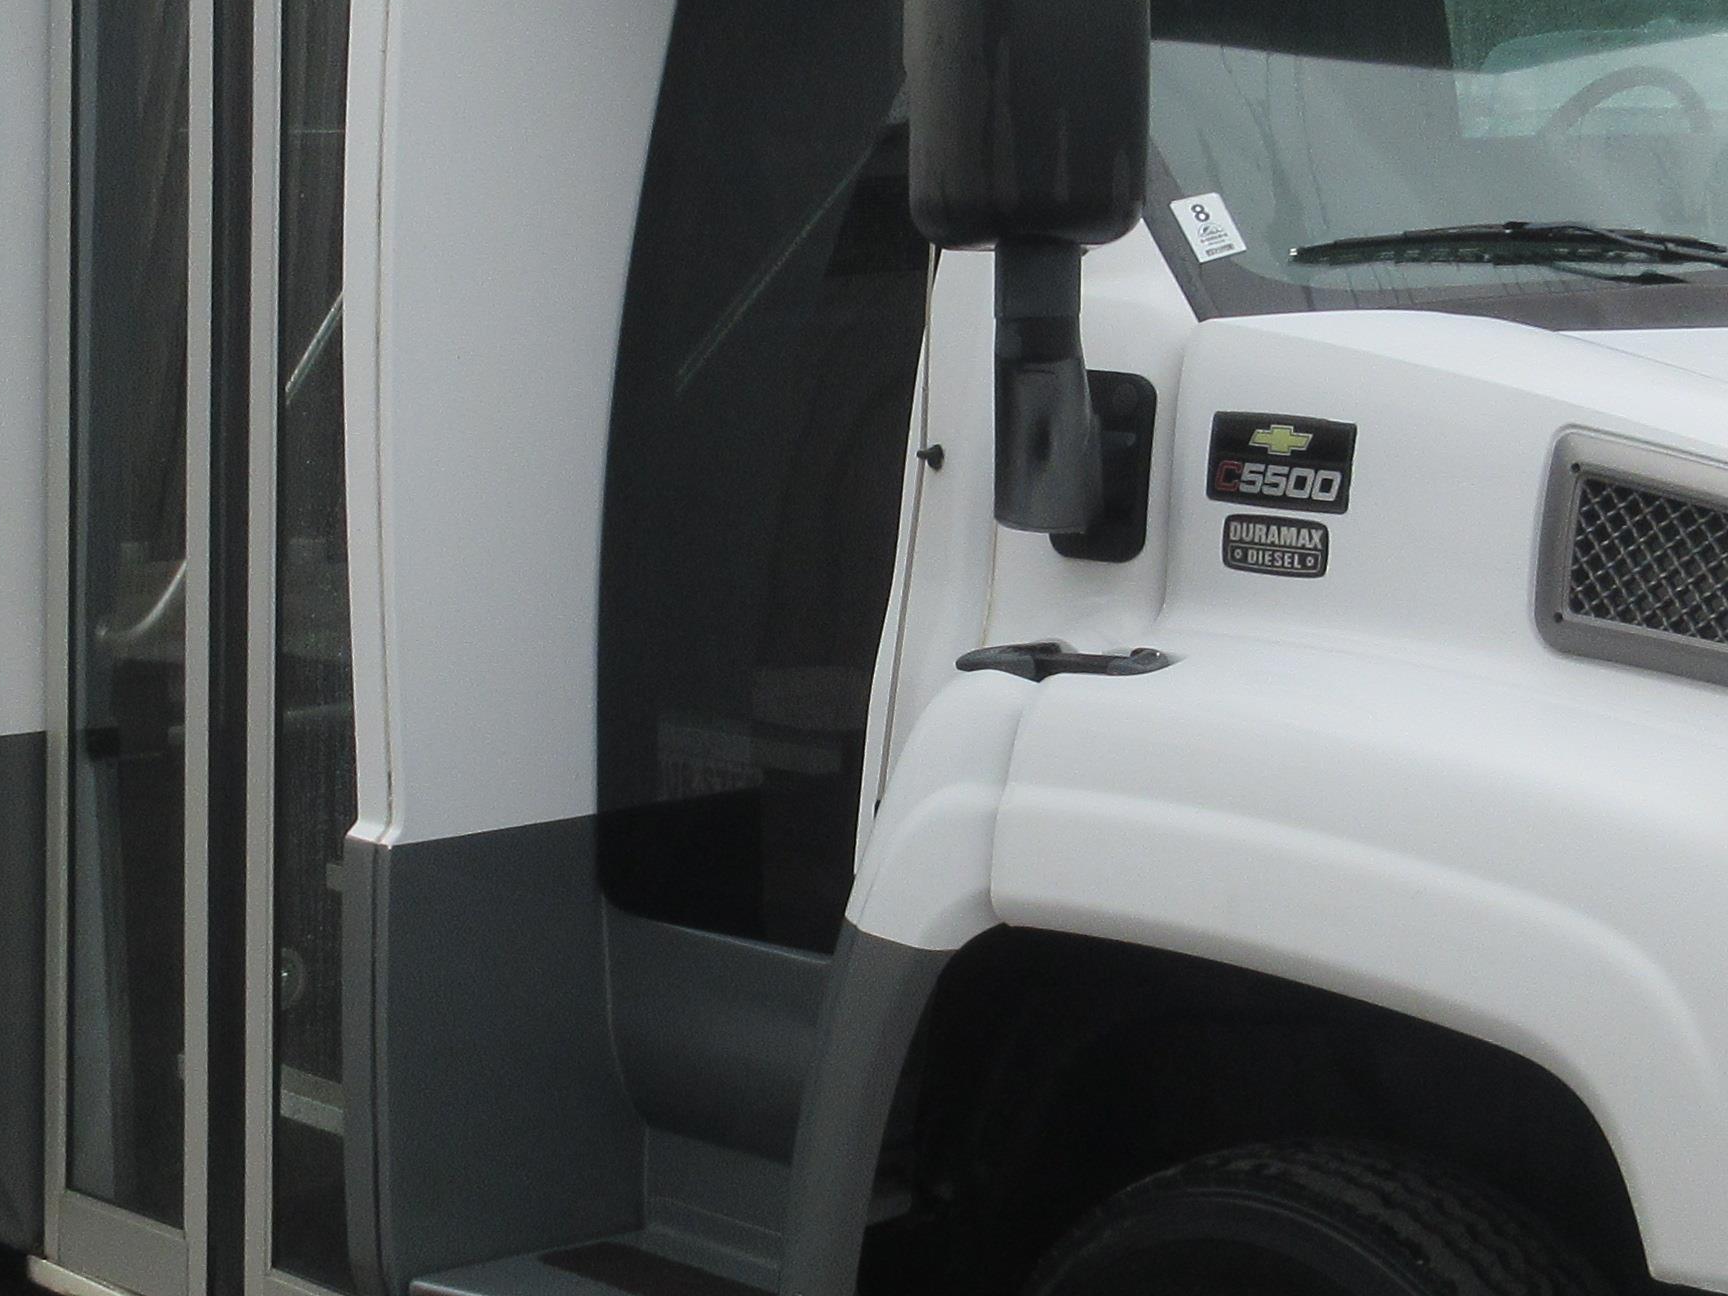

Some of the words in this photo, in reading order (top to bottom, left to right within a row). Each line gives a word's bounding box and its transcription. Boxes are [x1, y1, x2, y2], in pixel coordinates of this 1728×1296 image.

[1191, 204, 1210, 222] 8
[1216, 461, 1342, 501] C5500
[1230, 522, 1323, 549] DURAMAX
[1248, 550, 1302, 568] DIESEL
